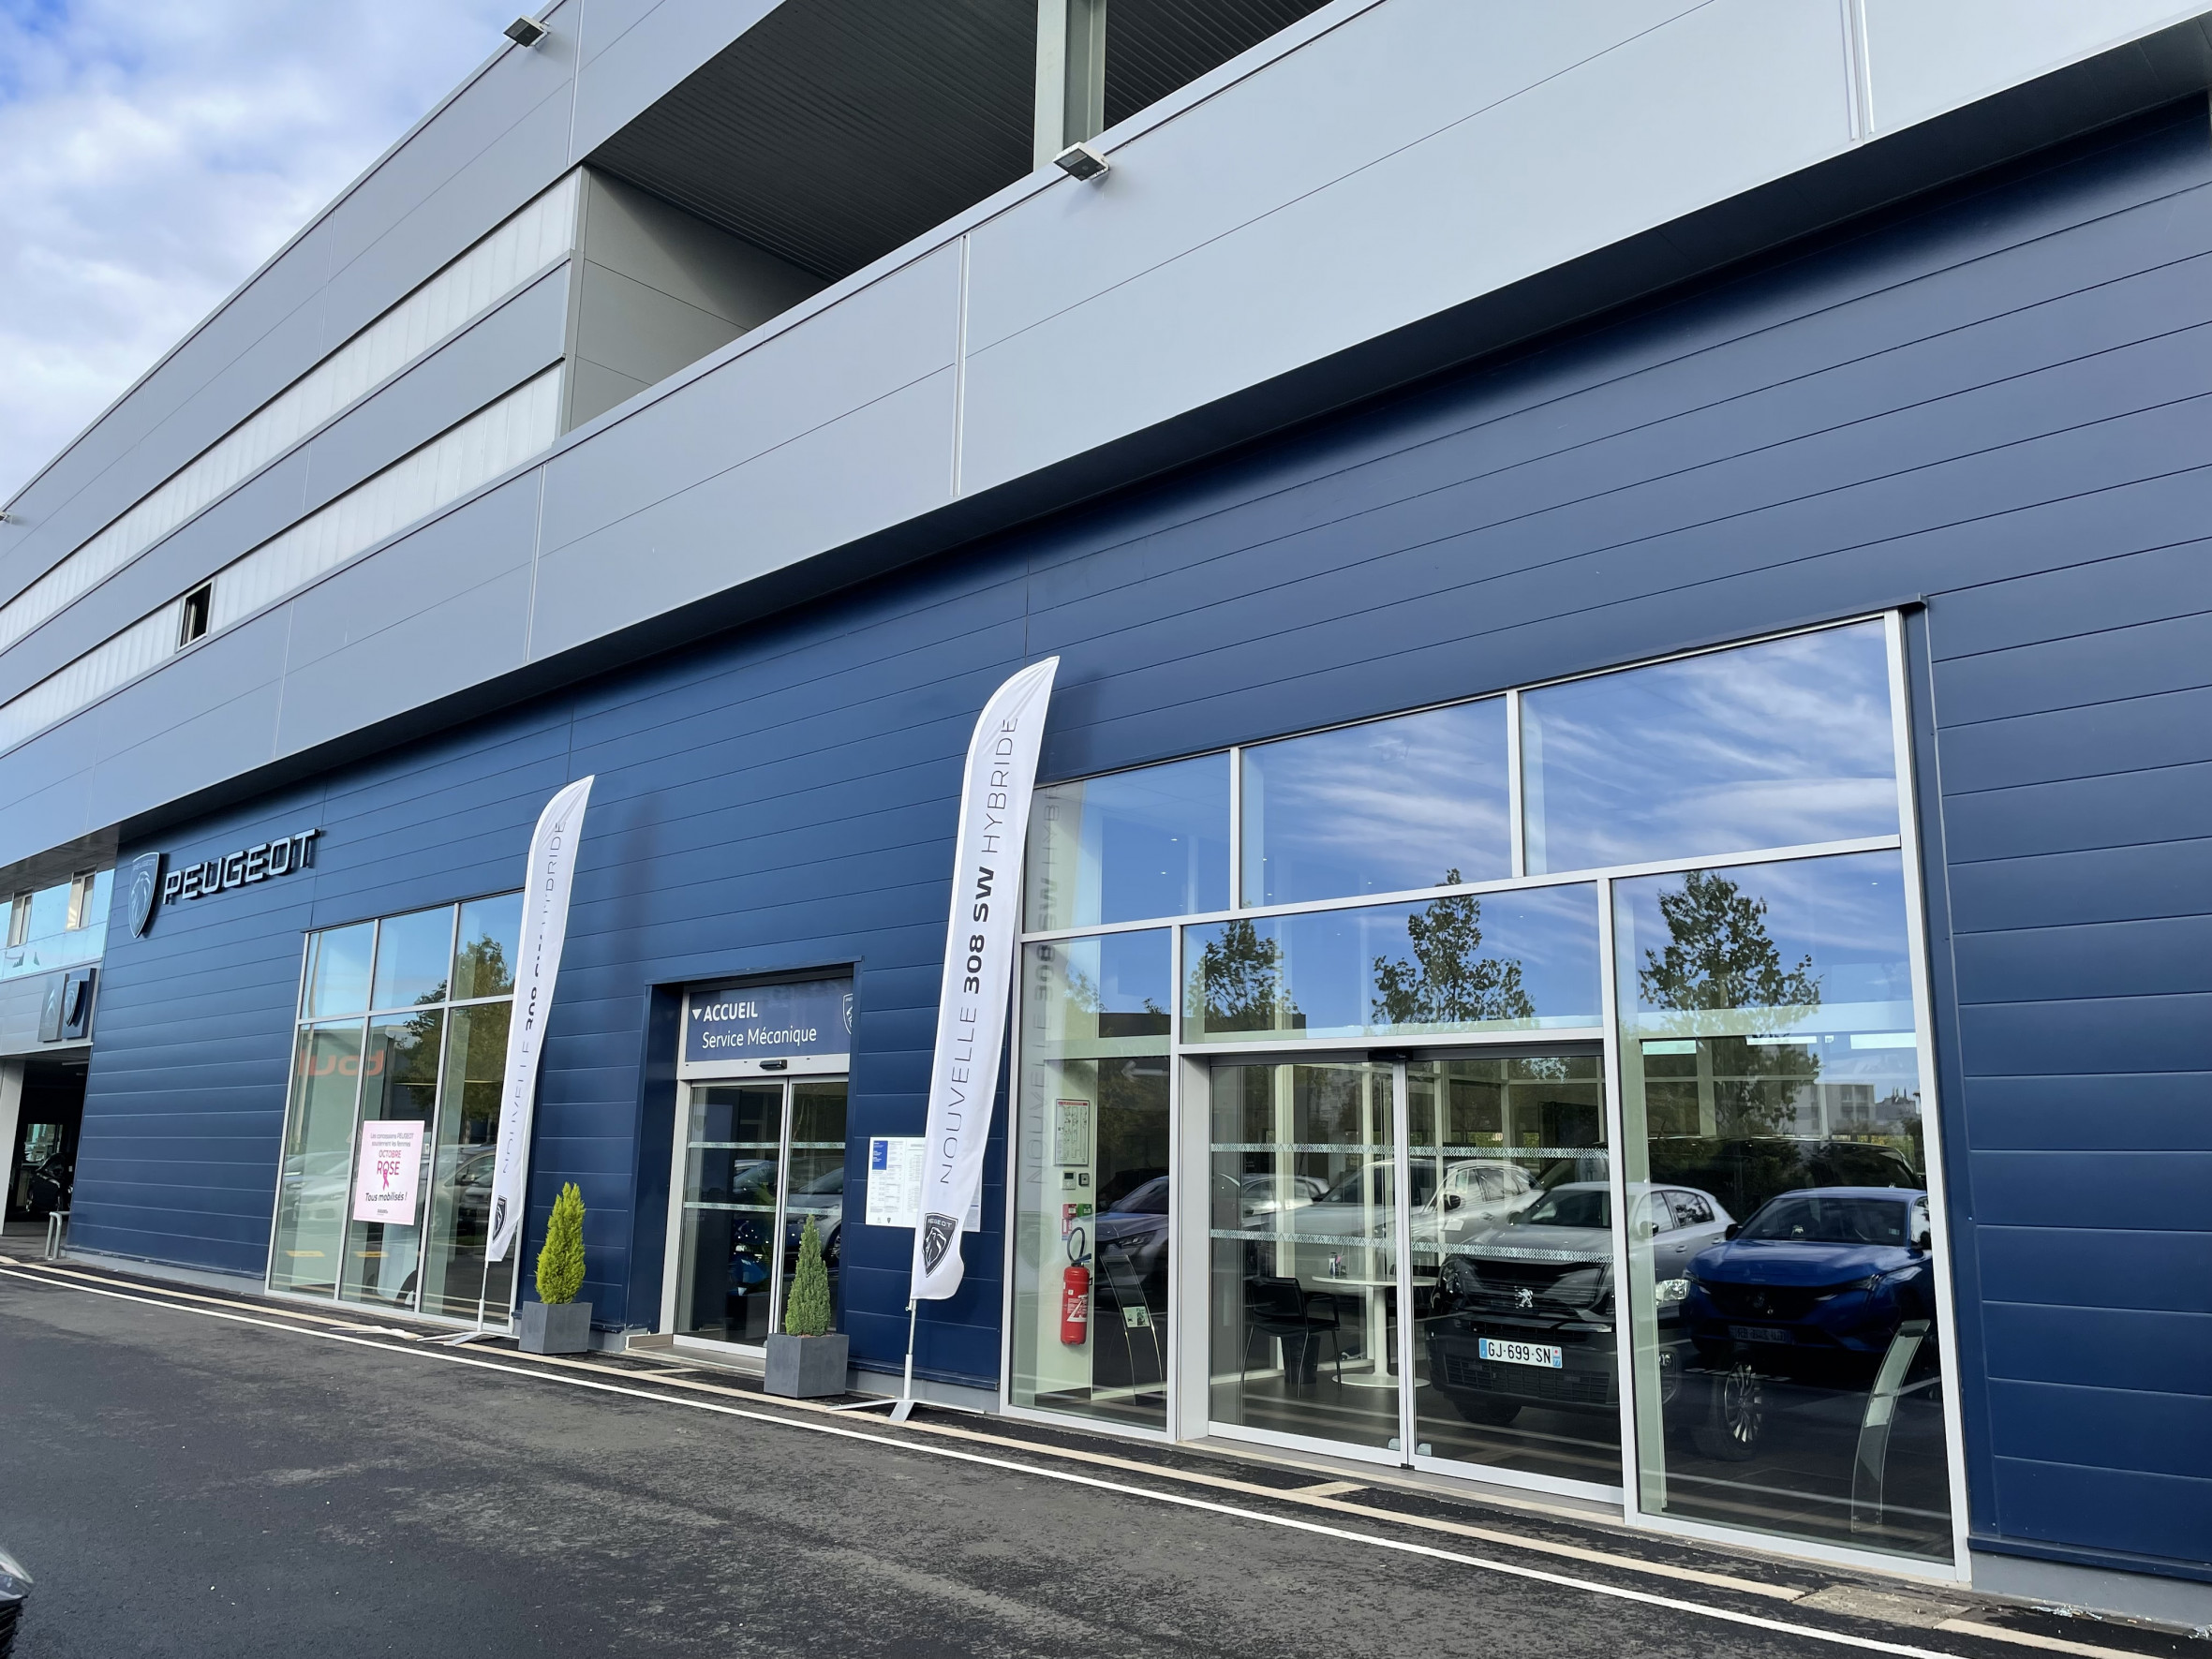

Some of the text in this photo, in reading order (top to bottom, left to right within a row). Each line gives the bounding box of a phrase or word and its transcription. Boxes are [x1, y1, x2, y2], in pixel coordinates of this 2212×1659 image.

[981, 718, 1018, 853] HYBRIDE
[162, 828, 319, 905] PEUGEOT
[972, 866, 994, 923] SW
[963, 934, 985, 994] 308
[703, 1001, 759, 1022] ACCUEIL
[702, 1026, 817, 1048] Service Mécanique
[940, 1006, 978, 1184] NOUVELLE
[377, 1161, 400, 1175] ROSE
[379, 1149, 402, 1158] OCTOBRE
[365, 1192, 378, 1201] Tous
[379, 1192, 404, 1201] mobilisés
